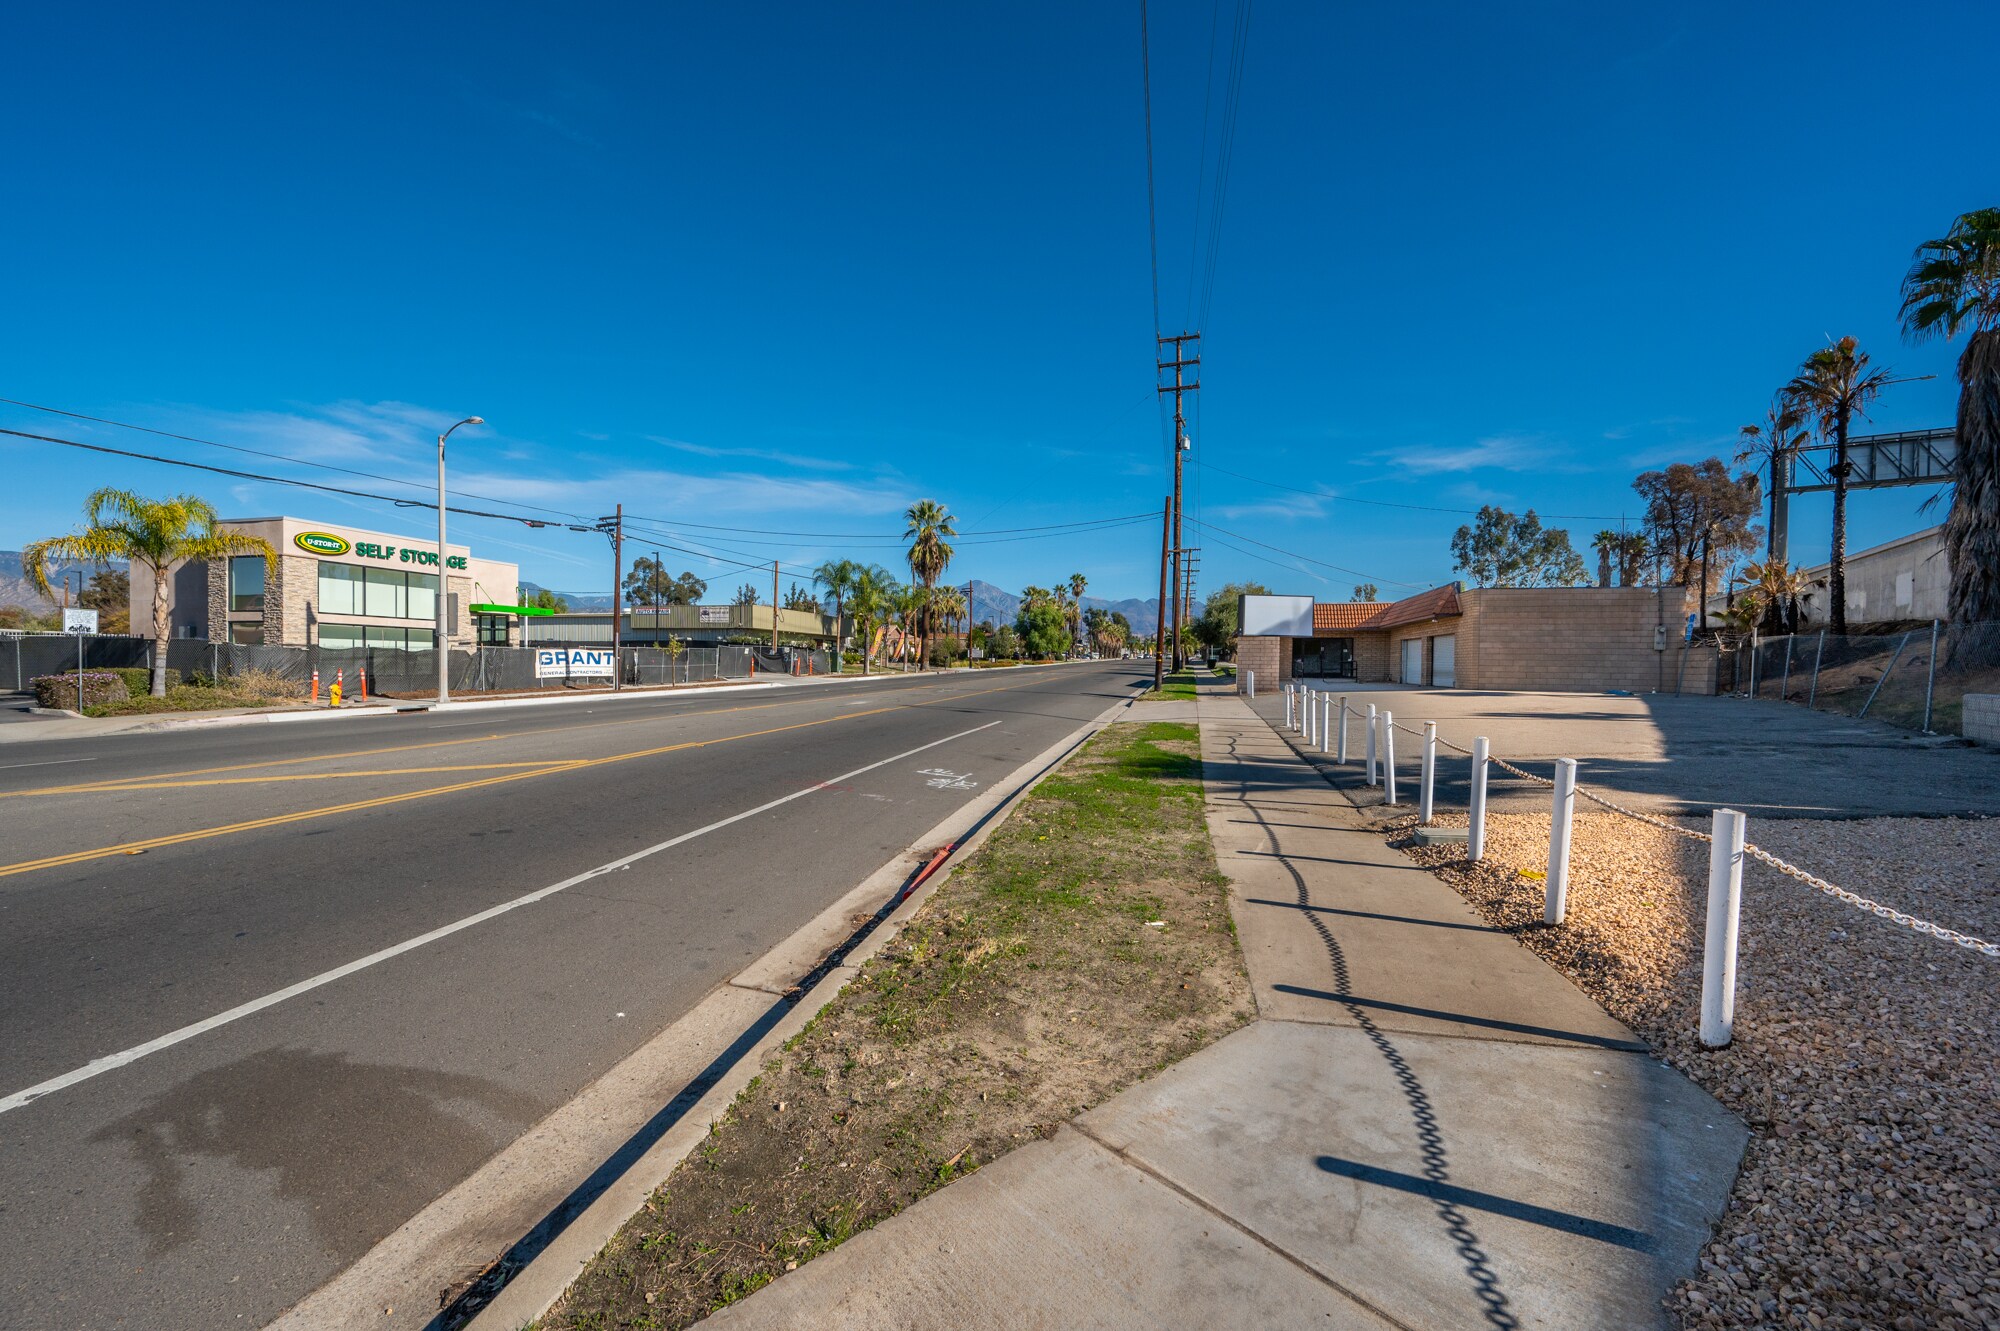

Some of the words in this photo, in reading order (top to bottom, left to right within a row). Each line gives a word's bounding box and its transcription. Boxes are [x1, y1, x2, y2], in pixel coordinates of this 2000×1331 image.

[355, 541, 395, 560] SELF
[399, 548, 467, 570] STORGE
[539, 651, 614, 665] GRANT
